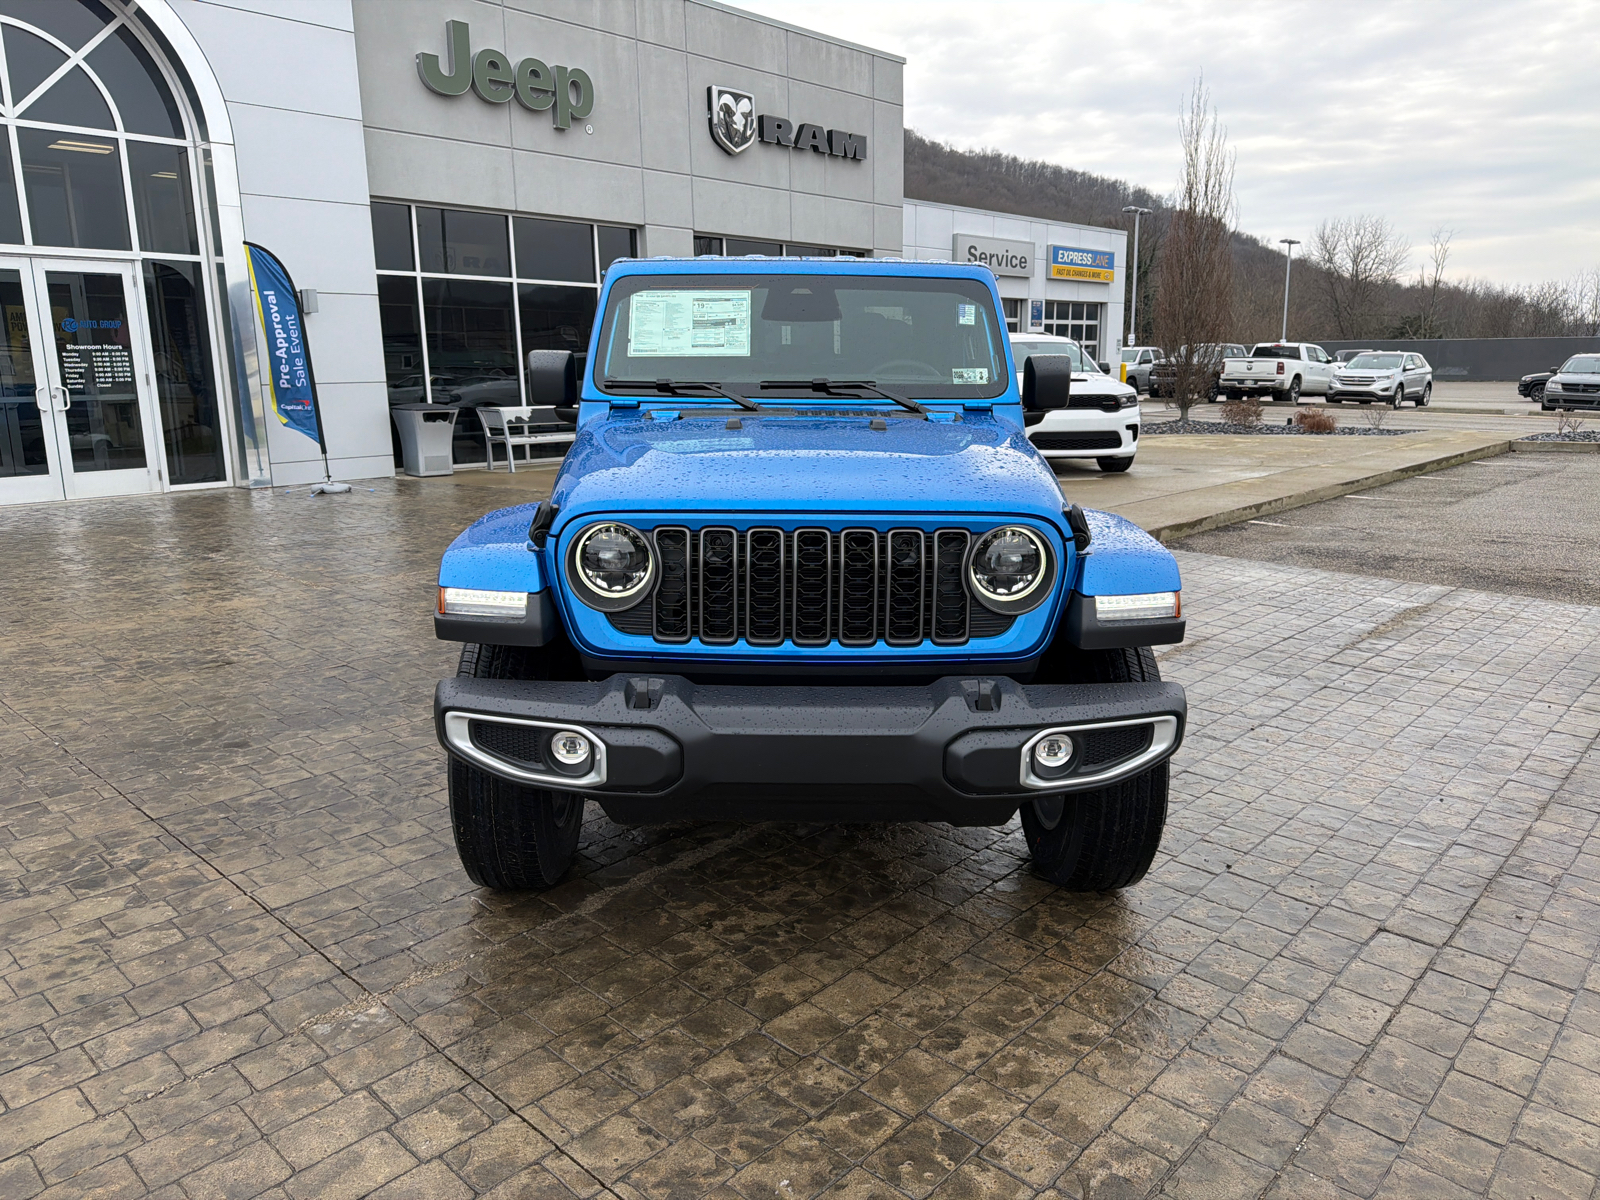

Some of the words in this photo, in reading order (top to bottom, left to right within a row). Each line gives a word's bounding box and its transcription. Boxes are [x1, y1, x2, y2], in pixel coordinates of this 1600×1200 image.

[416, 19, 594, 131] Jeep
[758, 114, 867, 160] RAM
[967, 245, 1028, 269] Service
[1056, 268, 1065, 276] FAST
[1072, 269, 1088, 278] CHANGES
[1092, 271, 1102, 279] MORE
[80, 320, 97, 329] AUTO
[100, 320, 122, 329] GROUP
[263, 290, 291, 389] Pre-Approval
[285, 314, 300, 354] Event
[293, 358, 307, 387] Sale
